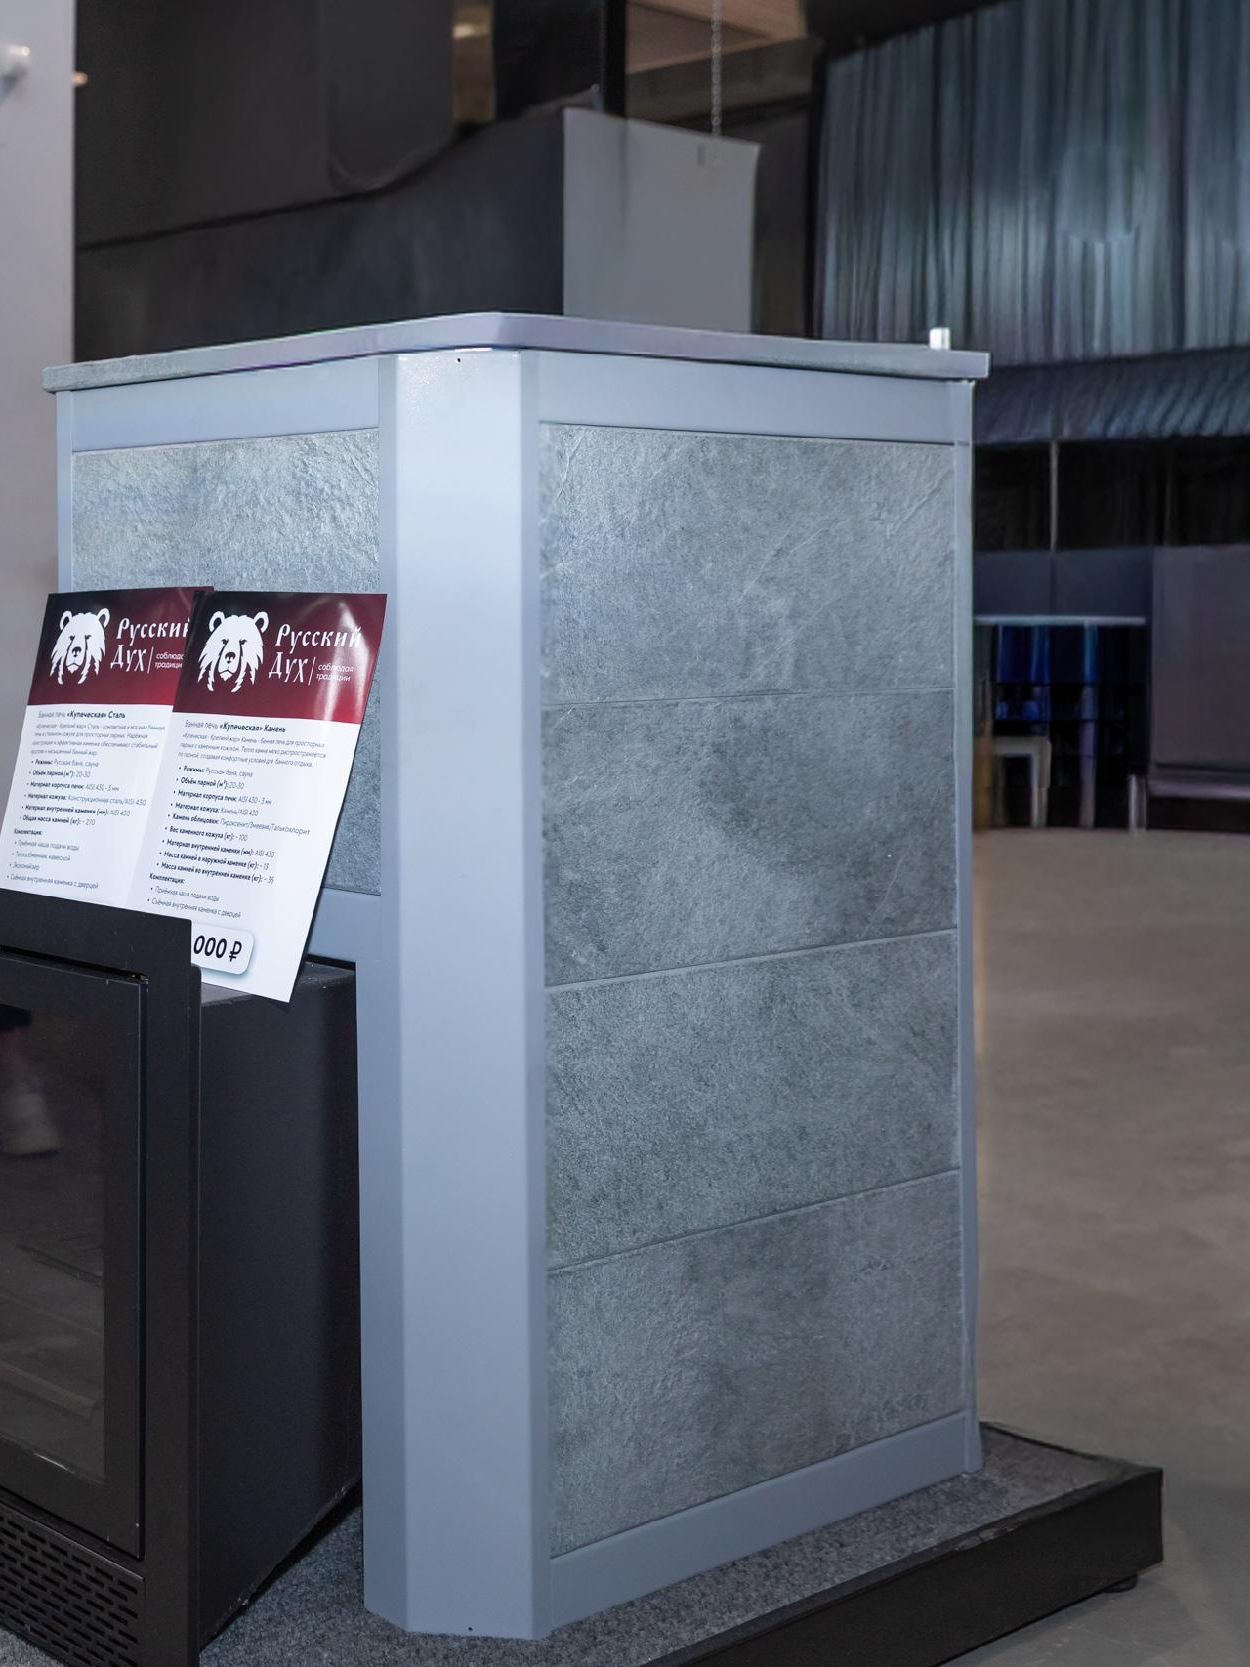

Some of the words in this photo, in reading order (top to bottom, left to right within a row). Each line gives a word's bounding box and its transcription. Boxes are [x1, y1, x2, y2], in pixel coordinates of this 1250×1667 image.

[275, 623, 362, 654] Русский
[110, 644, 147, 672] Дух
[156, 652, 184, 660] соблюда
[269, 651, 309, 683] Дух
[66, 710, 106, 719] «Купеческая»
[108, 710, 126, 718] Сталь
[220, 721, 263, 731] «Купеческая»
[197, 779, 216, 787] парной
[178, 789, 202, 799] Материал
[203, 793, 223, 802] корпуса
[175, 802, 199, 811] Материал
[170, 825, 178, 833] Вес
[180, 828, 204, 836] каменного
[167, 838, 190, 848] Материал
[191, 844, 220, 853] внутренней
[161, 861, 176, 870] Масса
[149, 872, 185, 884] Комплектация:
